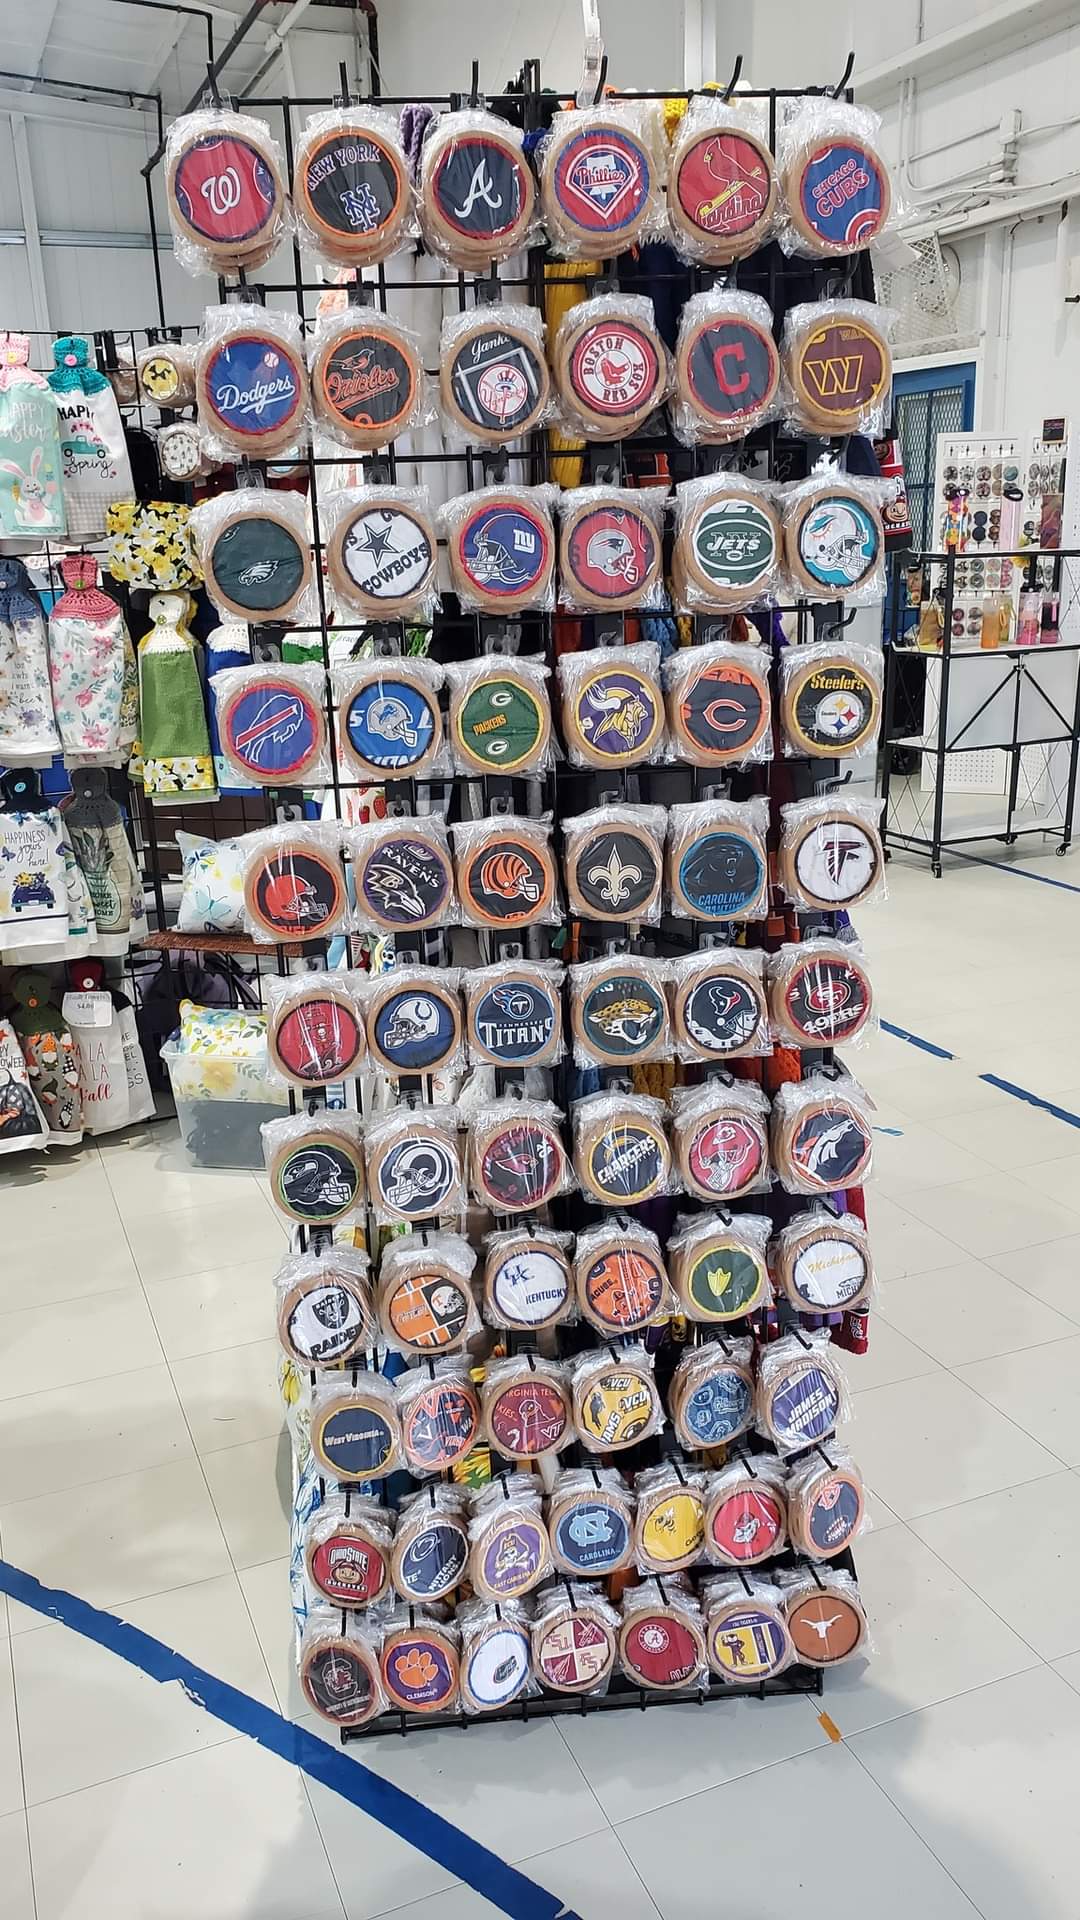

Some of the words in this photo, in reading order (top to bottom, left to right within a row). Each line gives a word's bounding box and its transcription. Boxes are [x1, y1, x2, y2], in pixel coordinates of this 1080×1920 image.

[306, 158, 335, 191] NEW
[333, 145, 381, 169] YORK
[577, 166, 625, 187] Phillies
[811, 158, 858, 198] CHICAGO
[201, 166, 241, 215] W
[454, 158, 502, 219] A
[815, 172, 870, 218] CUBS
[583, 337, 625, 377] BOSTON
[714, 340, 750, 396] C
[628, 361, 644, 392] SOX
[804, 354, 863, 396] W
[216, 375, 296, 415] Dodgers
[602, 388, 628, 402] RED
[64, 457, 113, 479] Spring
[706, 536, 760, 551] JETS
[361, 542, 429, 594] COWBOYS
[810, 673, 865, 691] Steelers
[473, 714, 507, 737] PACKERS
[703, 698, 747, 732] C
[4, 829, 46, 844] HAPPINESS
[382, 846, 441, 888] RAVENS
[698, 891, 746, 906] CAROLINA
[802, 1003, 864, 1034] 49ERS
[597, 1135, 657, 1185] CHARGERS
[505, 1388, 539, 1398] IRGINIA
[623, 1390, 648, 1408] VCU
[788, 1388, 823, 1423] JAMES
[786, 1393, 834, 1438] MADISON
[345, 1547, 369, 1572] STATE
[579, 1548, 616, 1562] CAROLINA
